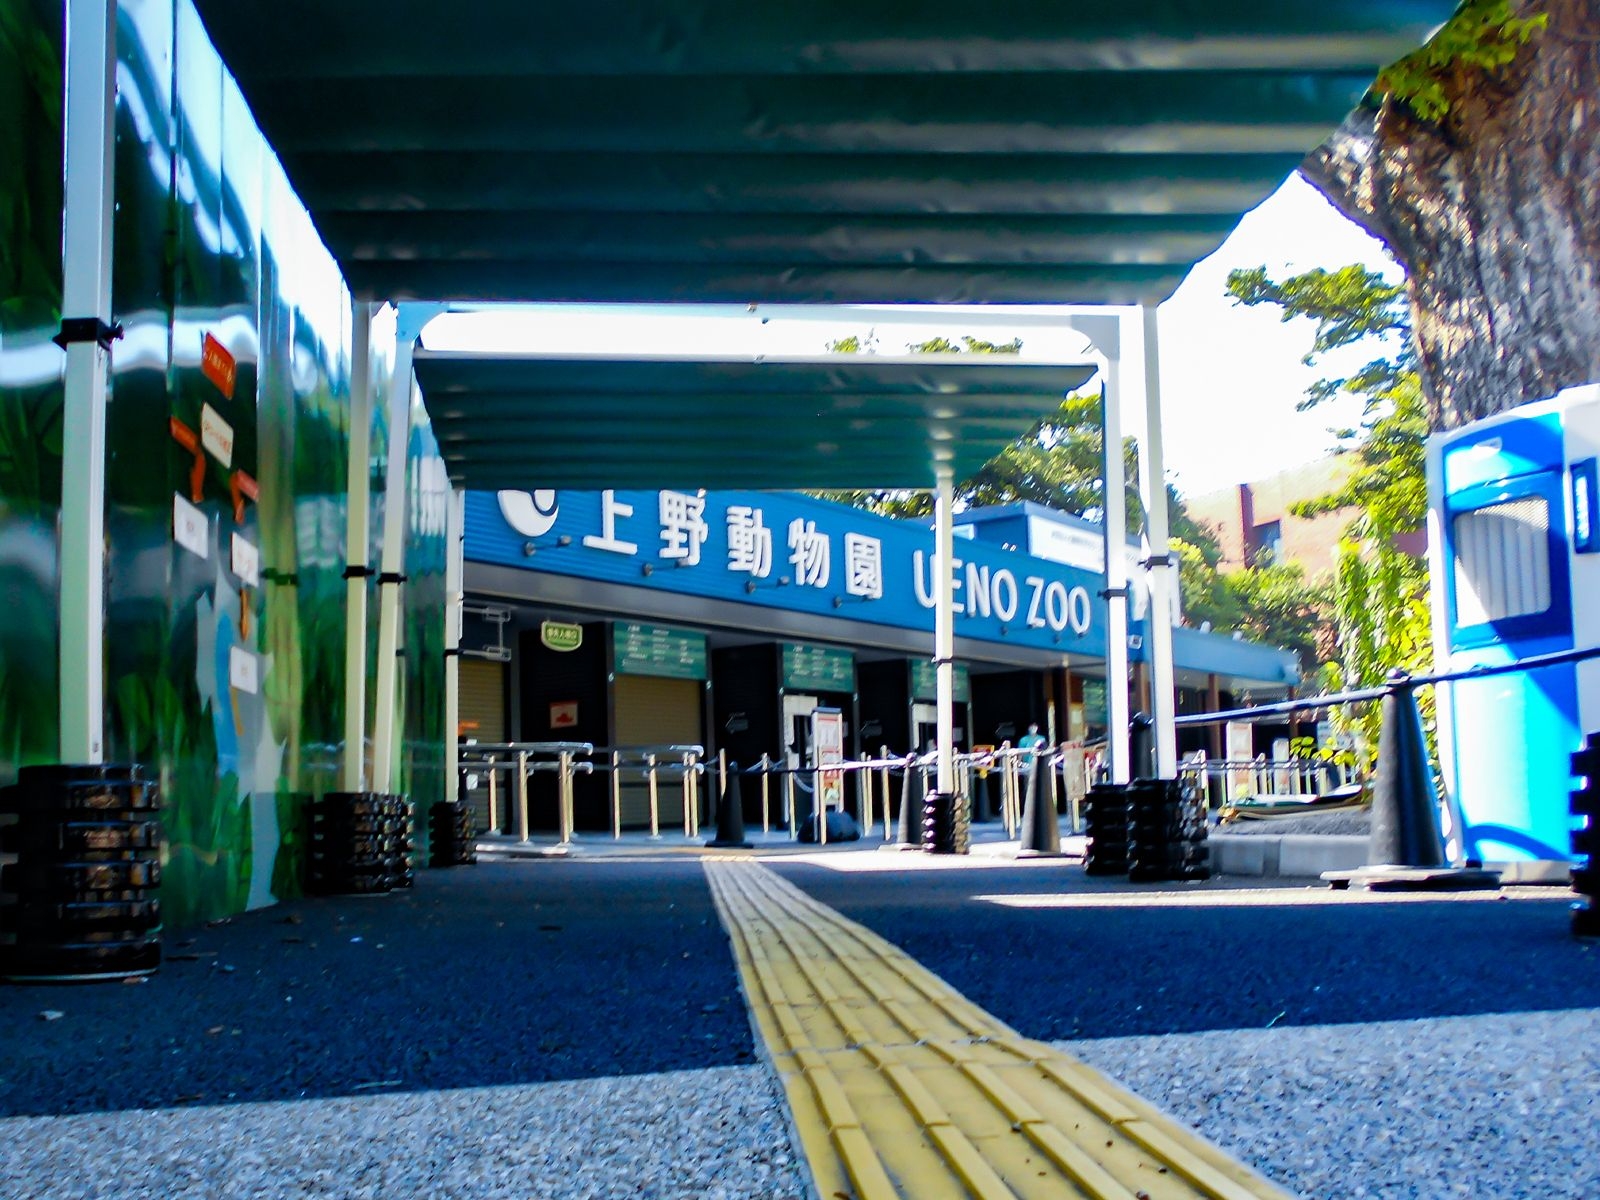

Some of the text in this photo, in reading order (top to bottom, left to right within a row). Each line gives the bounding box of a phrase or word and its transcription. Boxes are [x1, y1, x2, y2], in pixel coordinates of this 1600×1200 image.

[583, 489, 882, 599] 上野動物園
[913, 550, 1091, 634] UENO ZOO
